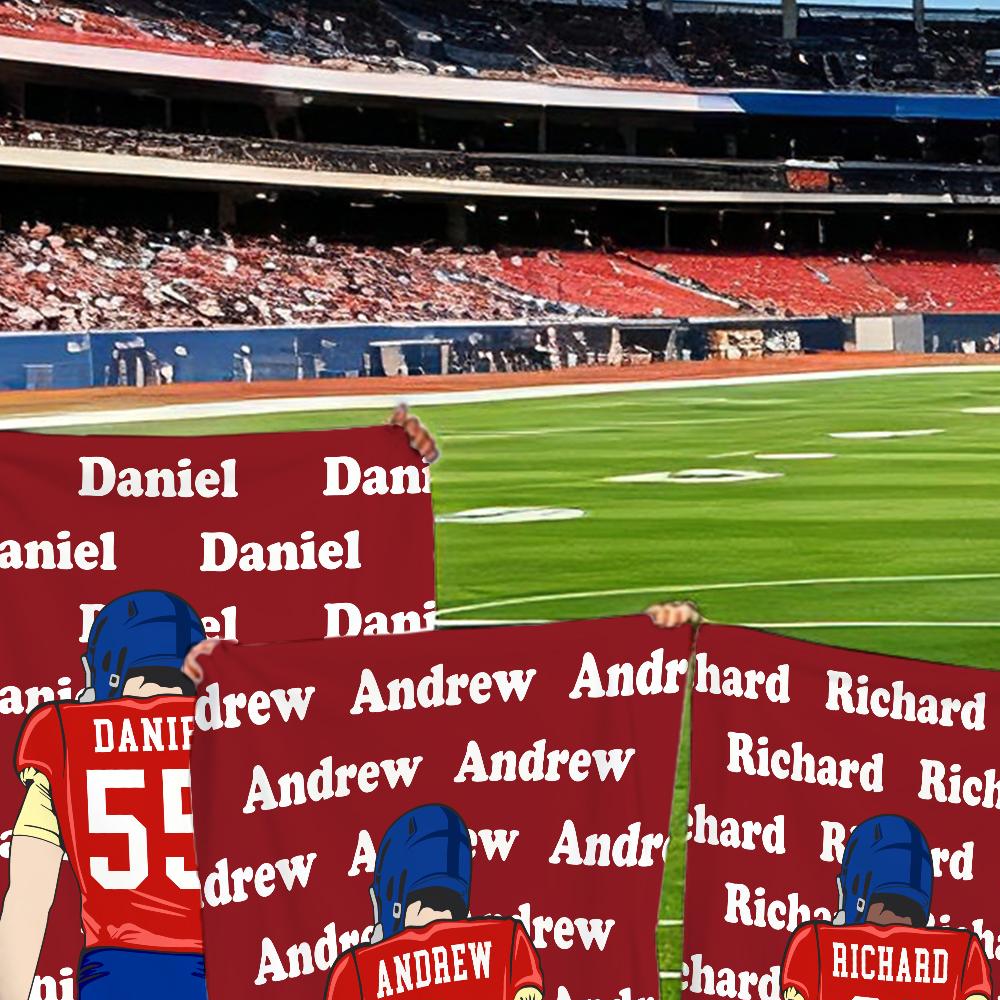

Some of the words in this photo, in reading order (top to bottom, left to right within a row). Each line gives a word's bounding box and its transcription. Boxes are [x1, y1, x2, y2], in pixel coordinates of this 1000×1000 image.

[78, 457, 239, 498] Daniel
[0, 531, 116, 571] aniel
[200, 530, 361, 571] Daniel
[350, 664, 536, 714] Andrew
[569, 648, 687, 698] Andr
[826, 670, 985, 730] Richard
[243, 756, 423, 813] Andrew
[454, 739, 635, 782] Andrew
[727, 732, 883, 792] Richard
[200, 853, 317, 908] drew
[377, 941, 491, 998] ANDREW
[833, 942, 948, 983] RICHARD
